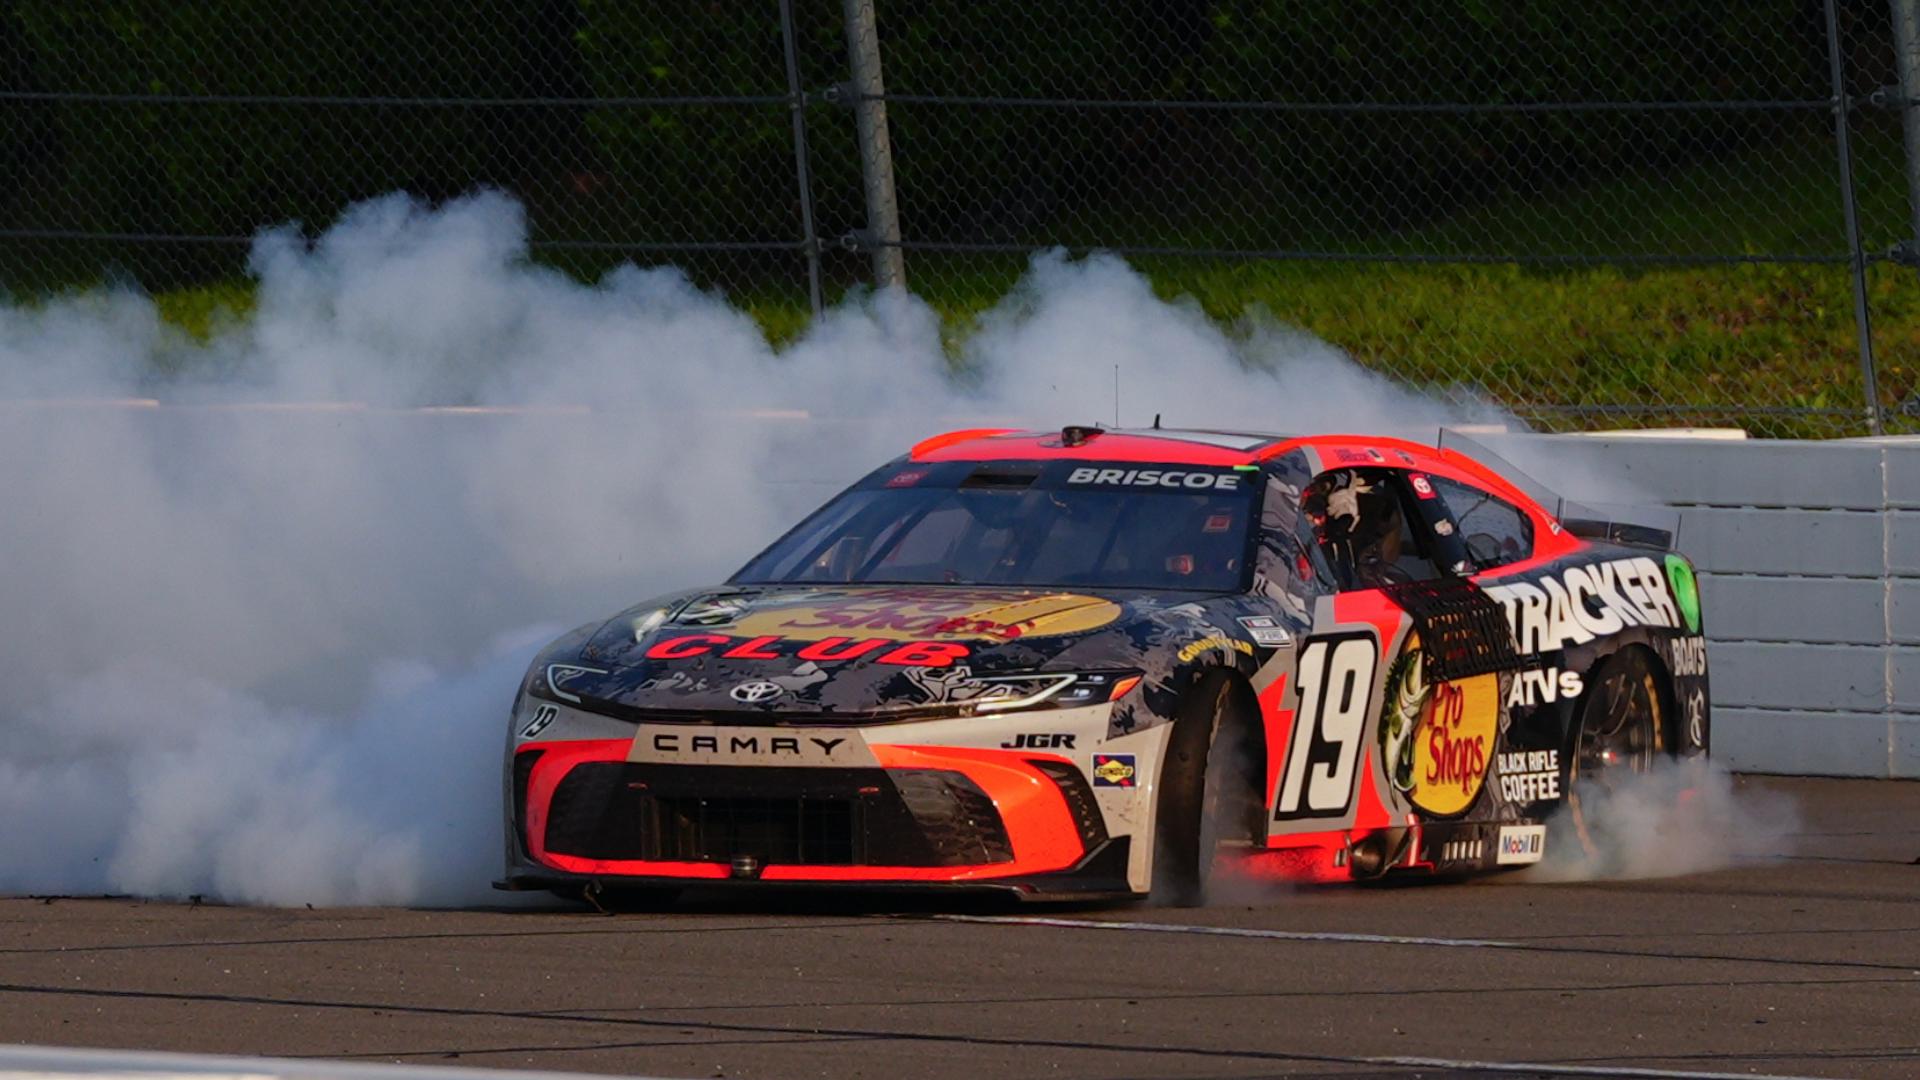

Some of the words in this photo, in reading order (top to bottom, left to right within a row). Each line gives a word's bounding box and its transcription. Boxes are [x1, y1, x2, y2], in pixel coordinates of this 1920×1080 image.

[1067, 467, 1241, 490] BRISCOE
[1480, 557, 1681, 655] TRACKER
[645, 634, 972, 667] CLUB
[1670, 636, 1705, 676] BOATS
[1507, 667, 1584, 708] ATVs
[518, 703, 559, 739] 19
[1426, 680, 1464, 729] Pro
[1001, 733, 1076, 750] JGR
[1277, 636, 1380, 819] 19
[653, 734, 847, 756] CAMRY
[1426, 726, 1484, 796] Shops
[1095, 766, 1134, 777] SUNOCO
[1498, 753, 1528, 774] BLACK
[1528, 750, 1559, 772] RIFLE
[1501, 771, 1561, 802] COFFEE
[1503, 835, 1530, 854] Mobil
